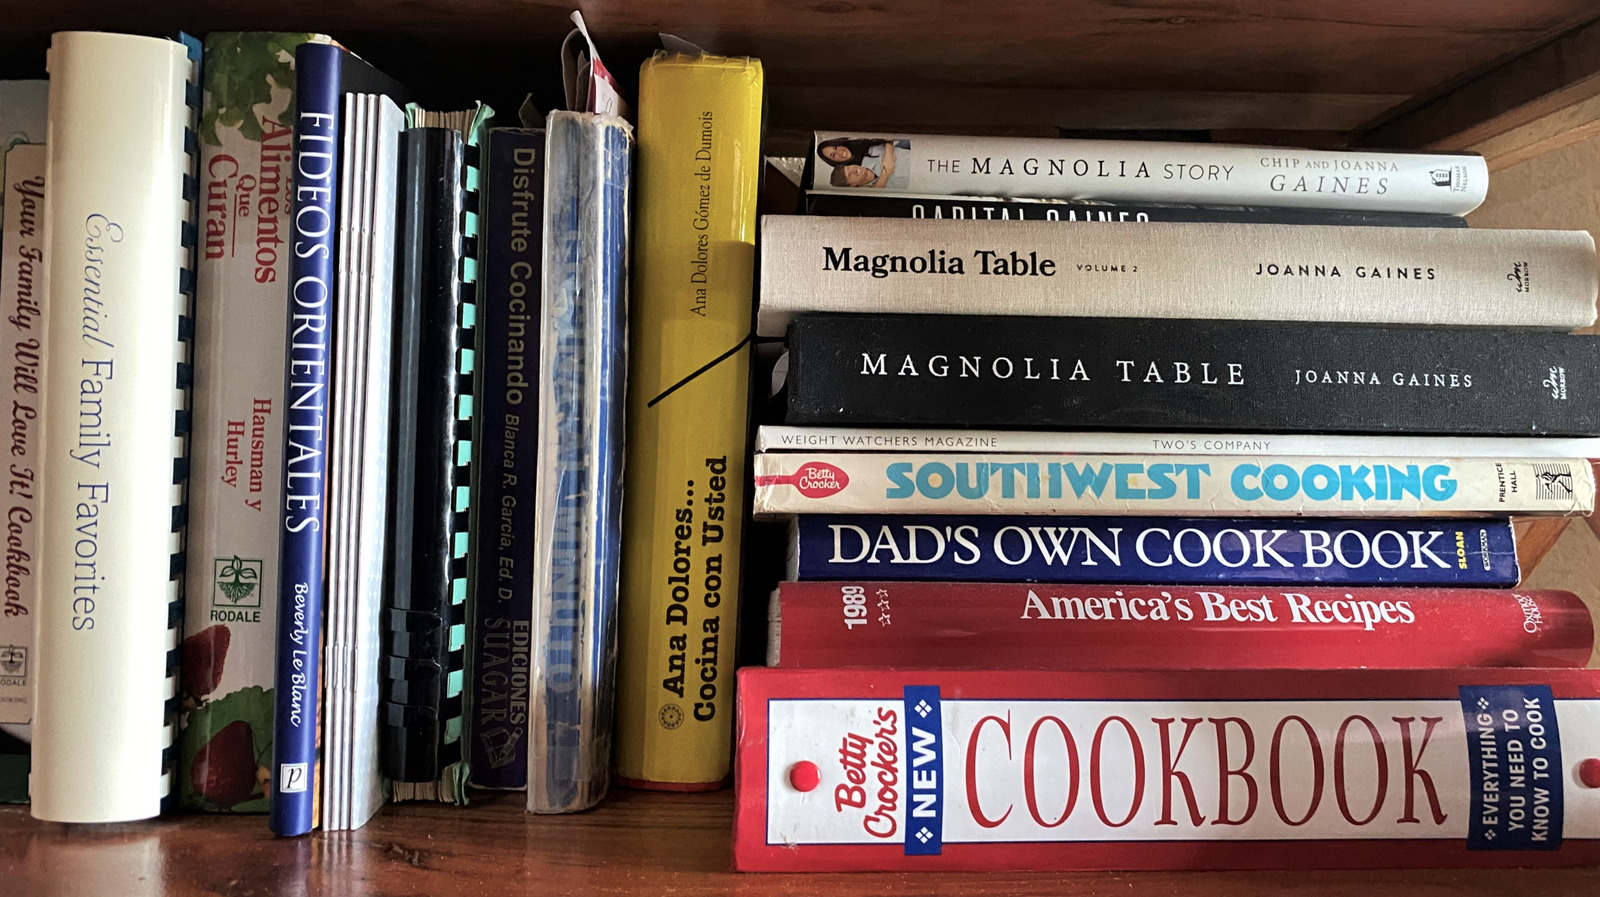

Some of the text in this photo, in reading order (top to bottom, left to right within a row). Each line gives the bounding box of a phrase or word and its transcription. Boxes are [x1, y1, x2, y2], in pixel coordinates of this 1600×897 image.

[236, 174, 257, 217] Que
[927, 157, 1235, 181] THE MAGNOLIA STORY
[1260, 157, 1399, 172] CHIP AND JOANNA
[1270, 174, 1390, 195] GAINES
[205, 154, 239, 261] Curan
[254, 115, 294, 284] Alimentos
[690, 110, 712, 317] Ana Dolores Gómez de Dumois
[822, 247, 965, 278] Magnolia
[974, 249, 1057, 277] Table
[1076, 264, 1127, 272] VOLUME
[1256, 263, 1436, 280] JOANNA GAINES
[286, 111, 335, 533] FIDEOS ORIENTALES
[4, 176, 45, 618] Your Family Will Love It! Cookbook
[498, 148, 536, 603] Disfrute Cocinando Blanca R. García, Ed. D.
[861, 353, 1473, 388] MAGNOLIA TABLE JOANNA GAINES
[69, 213, 124, 631] Essential Family Favorites
[781, 435, 1272, 450] WEIGHT WATCHERS MAGAZINE TWO'S COMPANY
[220, 419, 246, 488] Hurley
[243, 397, 272, 512] Hausman y
[799, 476, 841, 490] Crocker
[805, 467, 835, 481] Betty
[886, 461, 1458, 501] SOUTHWEST COOKING
[1495, 462, 1506, 503] PRENTICE
[1509, 470, 1518, 493] HALL
[828, 525, 1452, 570] DAD'S OWN COOK BOOK
[1455, 531, 1467, 569] SLOAN
[1480, 531, 1489, 568] WORKMAN
[210, 609, 261, 623] RODALE
[289, 582, 309, 644] Beverly
[662, 479, 695, 698] Ana Dolores...
[694, 456, 727, 722] Cocina con Usted
[842, 585, 867, 630] 1989
[1195, 592, 1278, 622] Best
[1281, 592, 1415, 631] Recipes
[0, 679, 26, 687] ODALE
[481, 618, 511, 725] SUAGAR
[510, 620, 530, 726] EDICIONES
[835, 732, 874, 813] Betty
[863, 706, 899, 839] Crocker's
[912, 725, 937, 818] NEW
[965, 708, 1448, 829] COOKBOOK
[1481, 711, 1500, 826] EVERYTHING
[1503, 708, 1525, 832] YOU NEED TO
[1523, 697, 1550, 842] KNOW TO COOK
